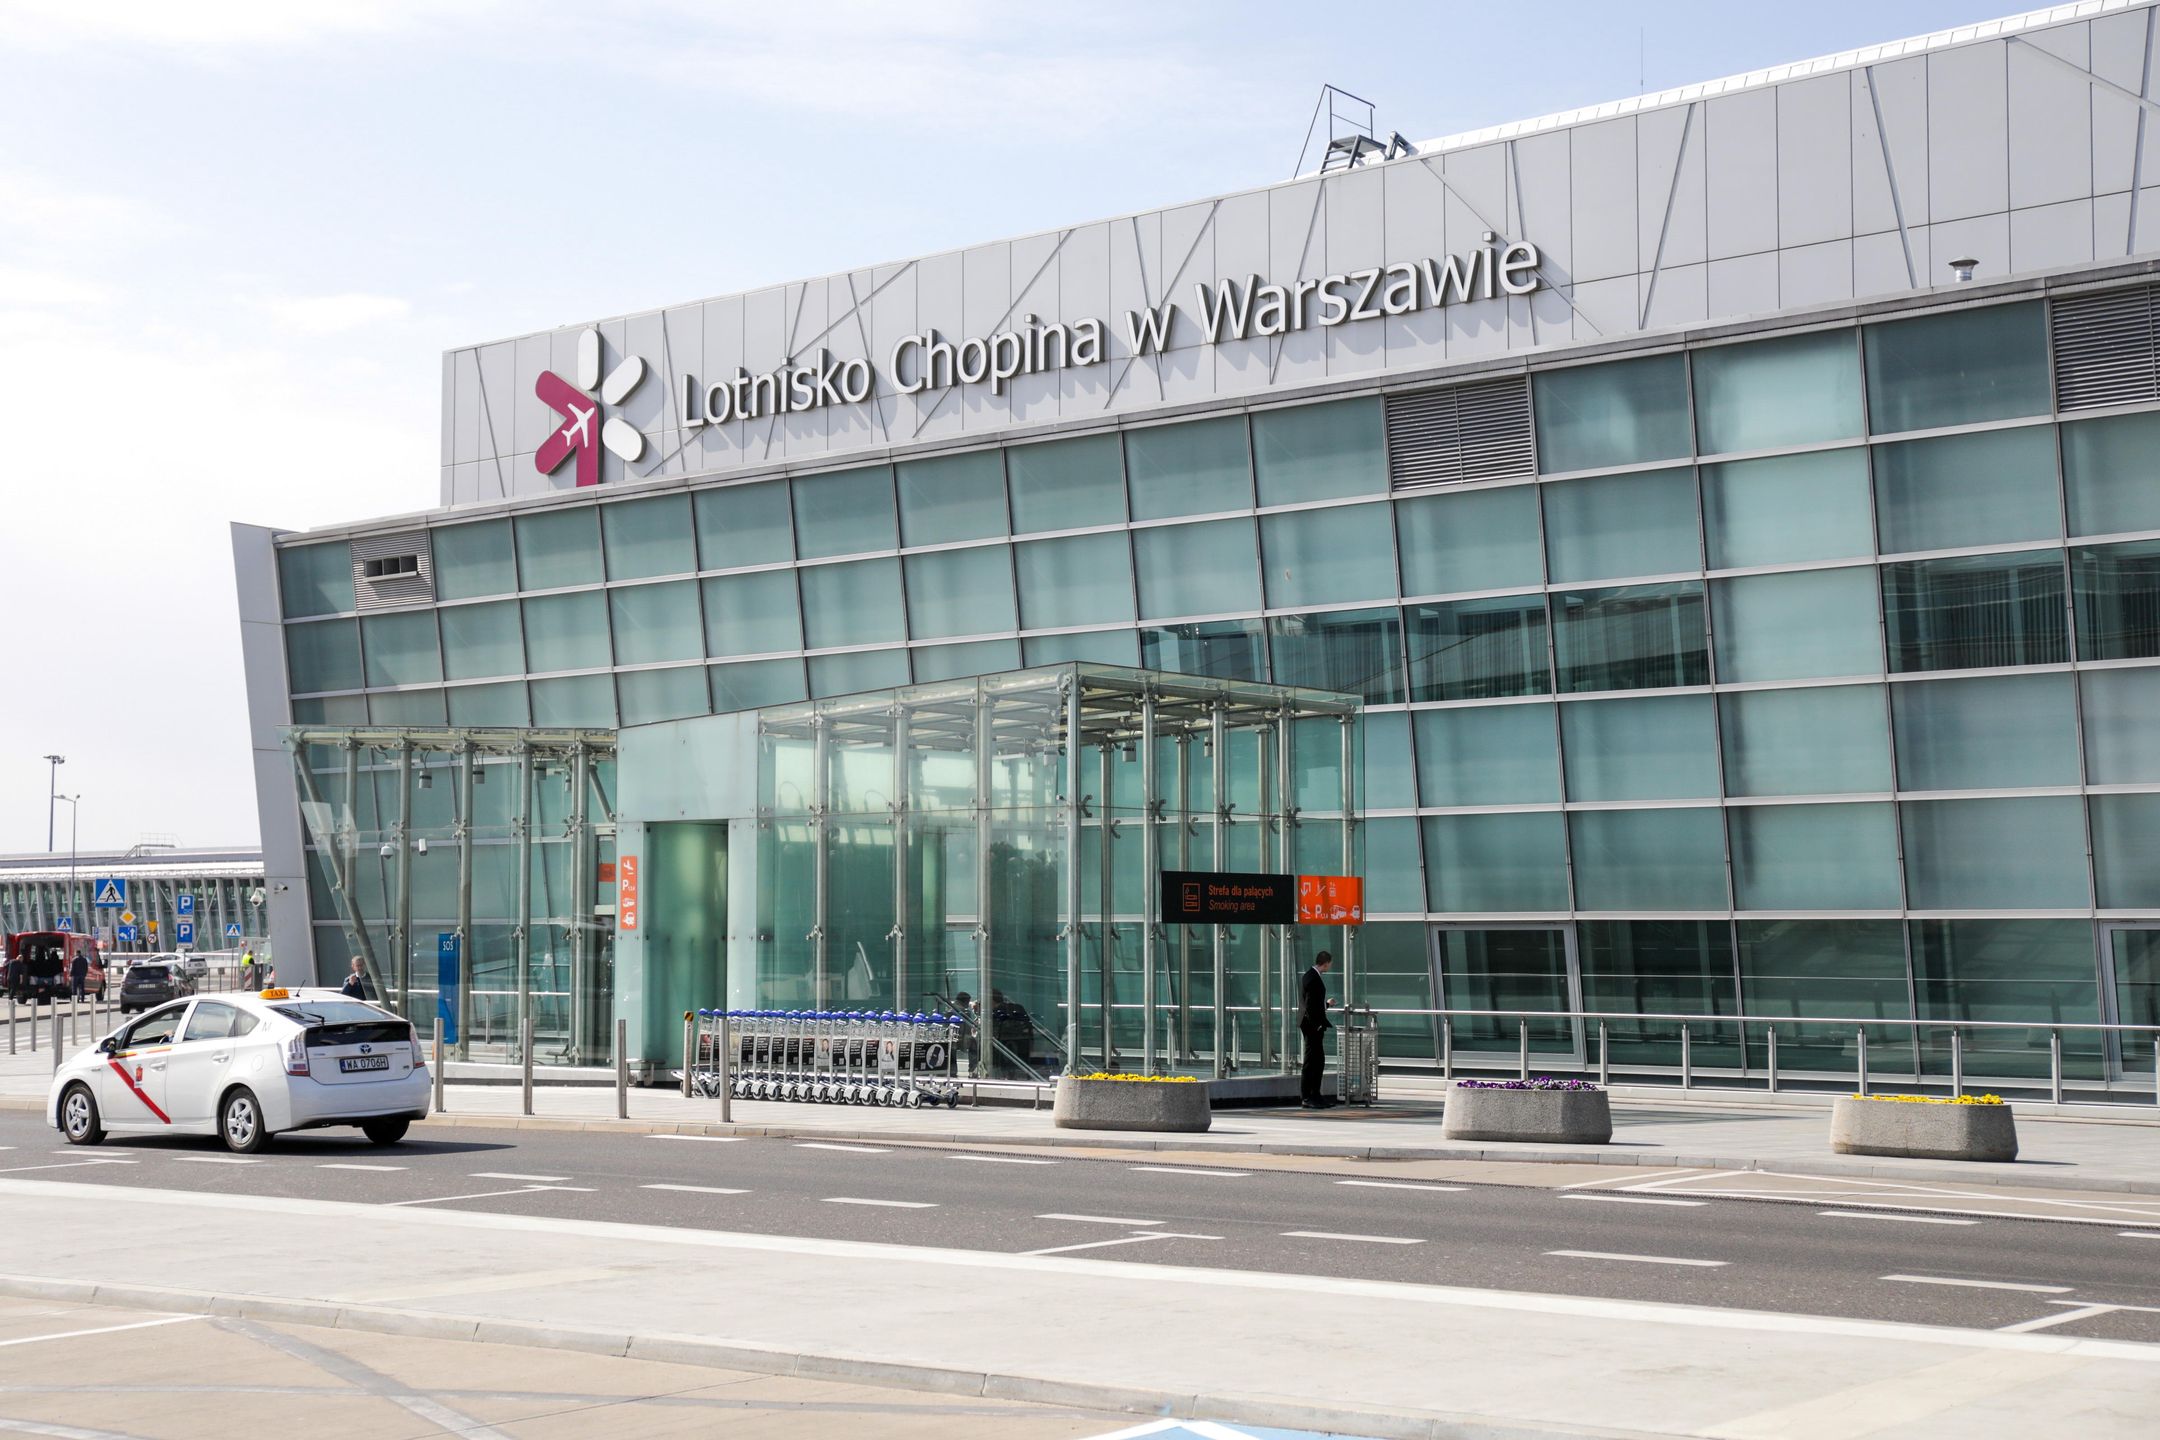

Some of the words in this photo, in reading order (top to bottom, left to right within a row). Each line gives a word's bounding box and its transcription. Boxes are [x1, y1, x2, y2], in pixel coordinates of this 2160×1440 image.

[681, 347, 875, 429] Lotnisko
[889, 312, 1106, 395] Chopina
[1123, 303, 1176, 356] w
[1193, 231, 1542, 345] Warszawie
[1208, 884, 1230, 896] Strefa
[1231, 885, 1242, 896] dla
[1243, 886, 1274, 899] palących
[1208, 900, 1239, 912] Smoking
[1240, 902, 1256, 911] area
[443, 940, 454, 951] SOS
[270, 989, 286, 997] TAXI
[346, 1059, 358, 1071] WA
[360, 1057, 386, 1069] 0706H
